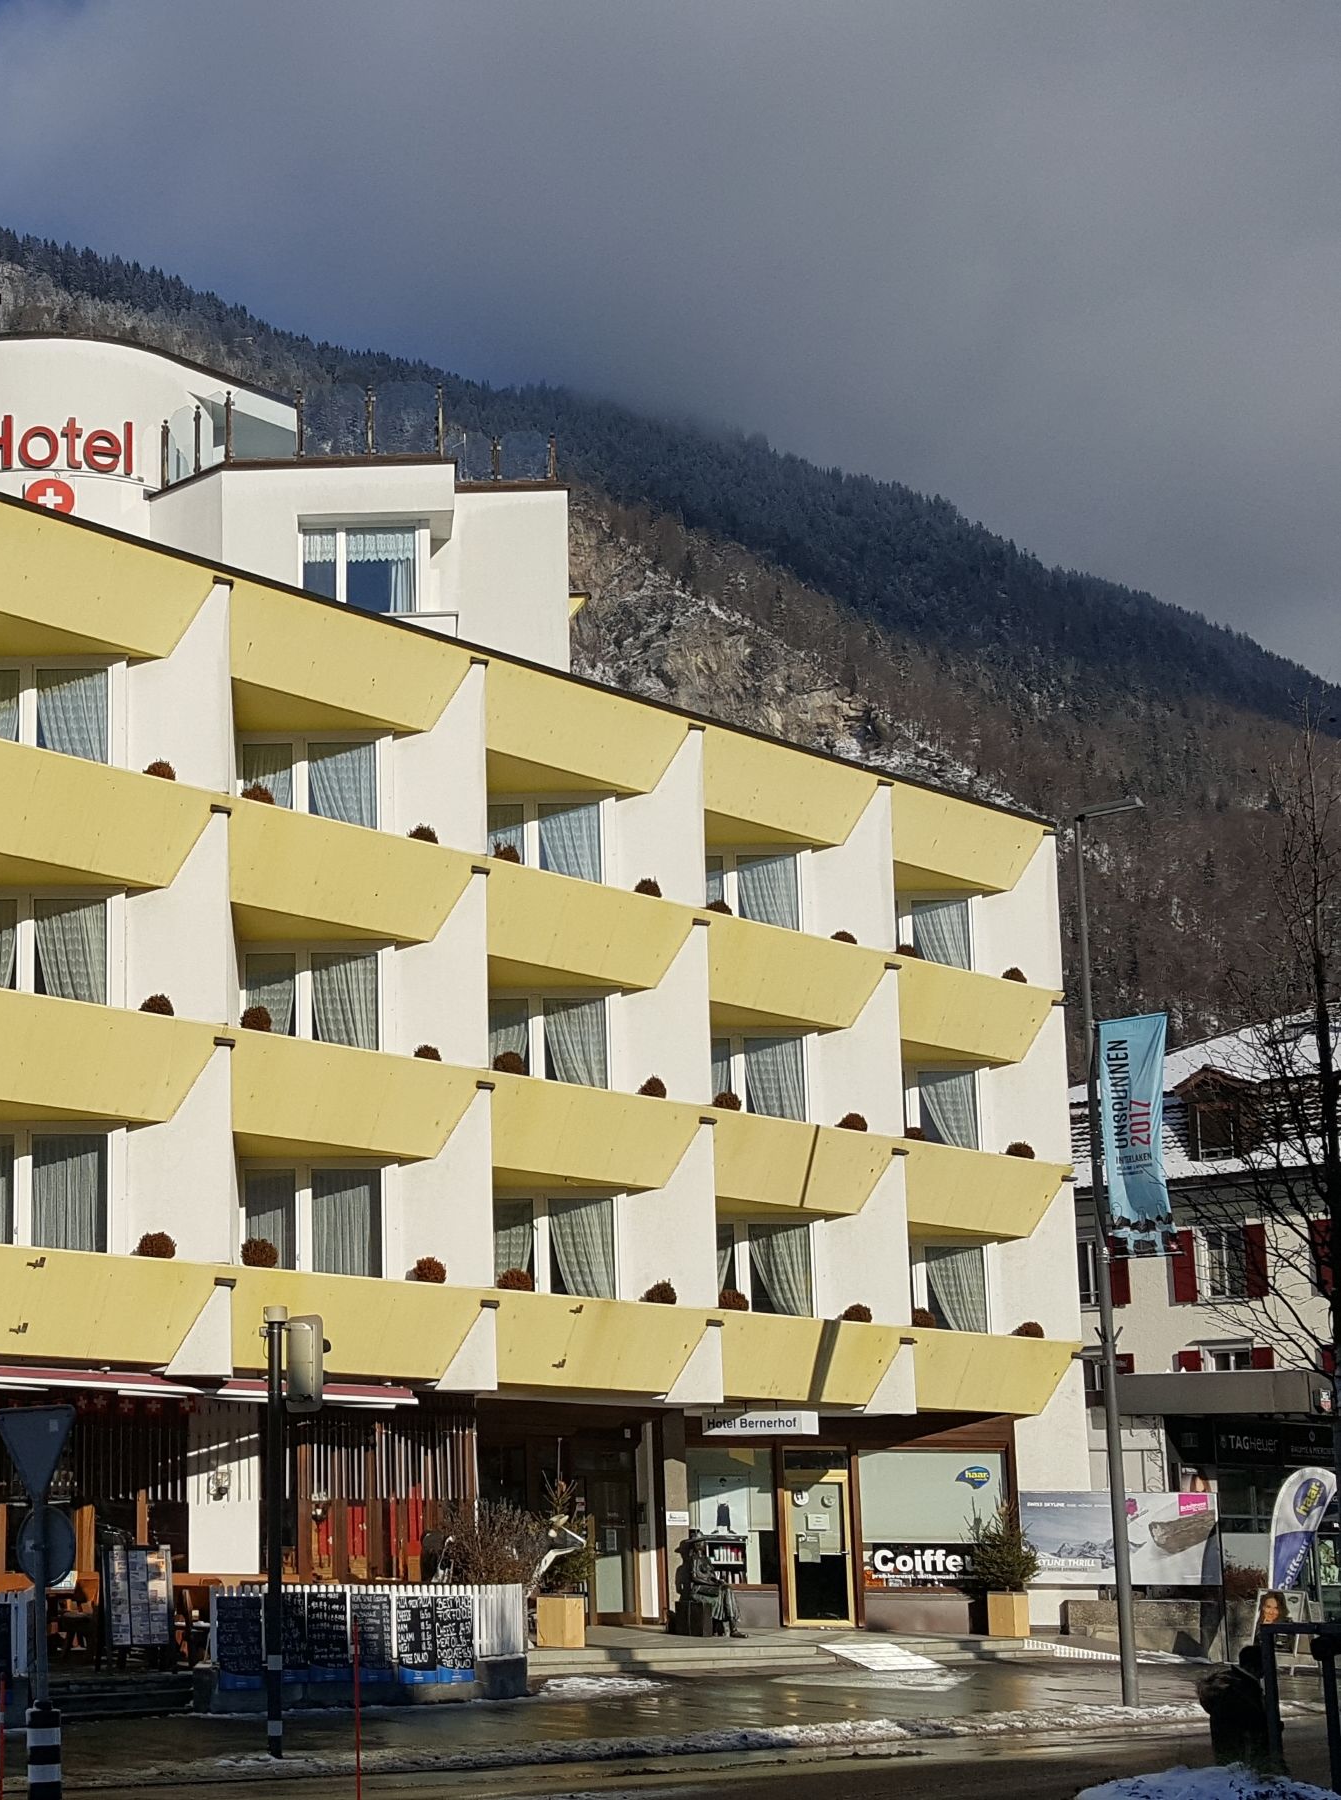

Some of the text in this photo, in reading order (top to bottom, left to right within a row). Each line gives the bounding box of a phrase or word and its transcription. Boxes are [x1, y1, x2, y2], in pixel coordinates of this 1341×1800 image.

[1107, 1039, 1130, 1149] UNSPUNNEN
[1129, 1099, 1152, 1148] 2017
[1116, 1152, 1153, 1165] INTERLAKEN
[707, 1417, 797, 1429] Hotel Bernerhof
[1068, 1559, 1096, 1567] THRILL
